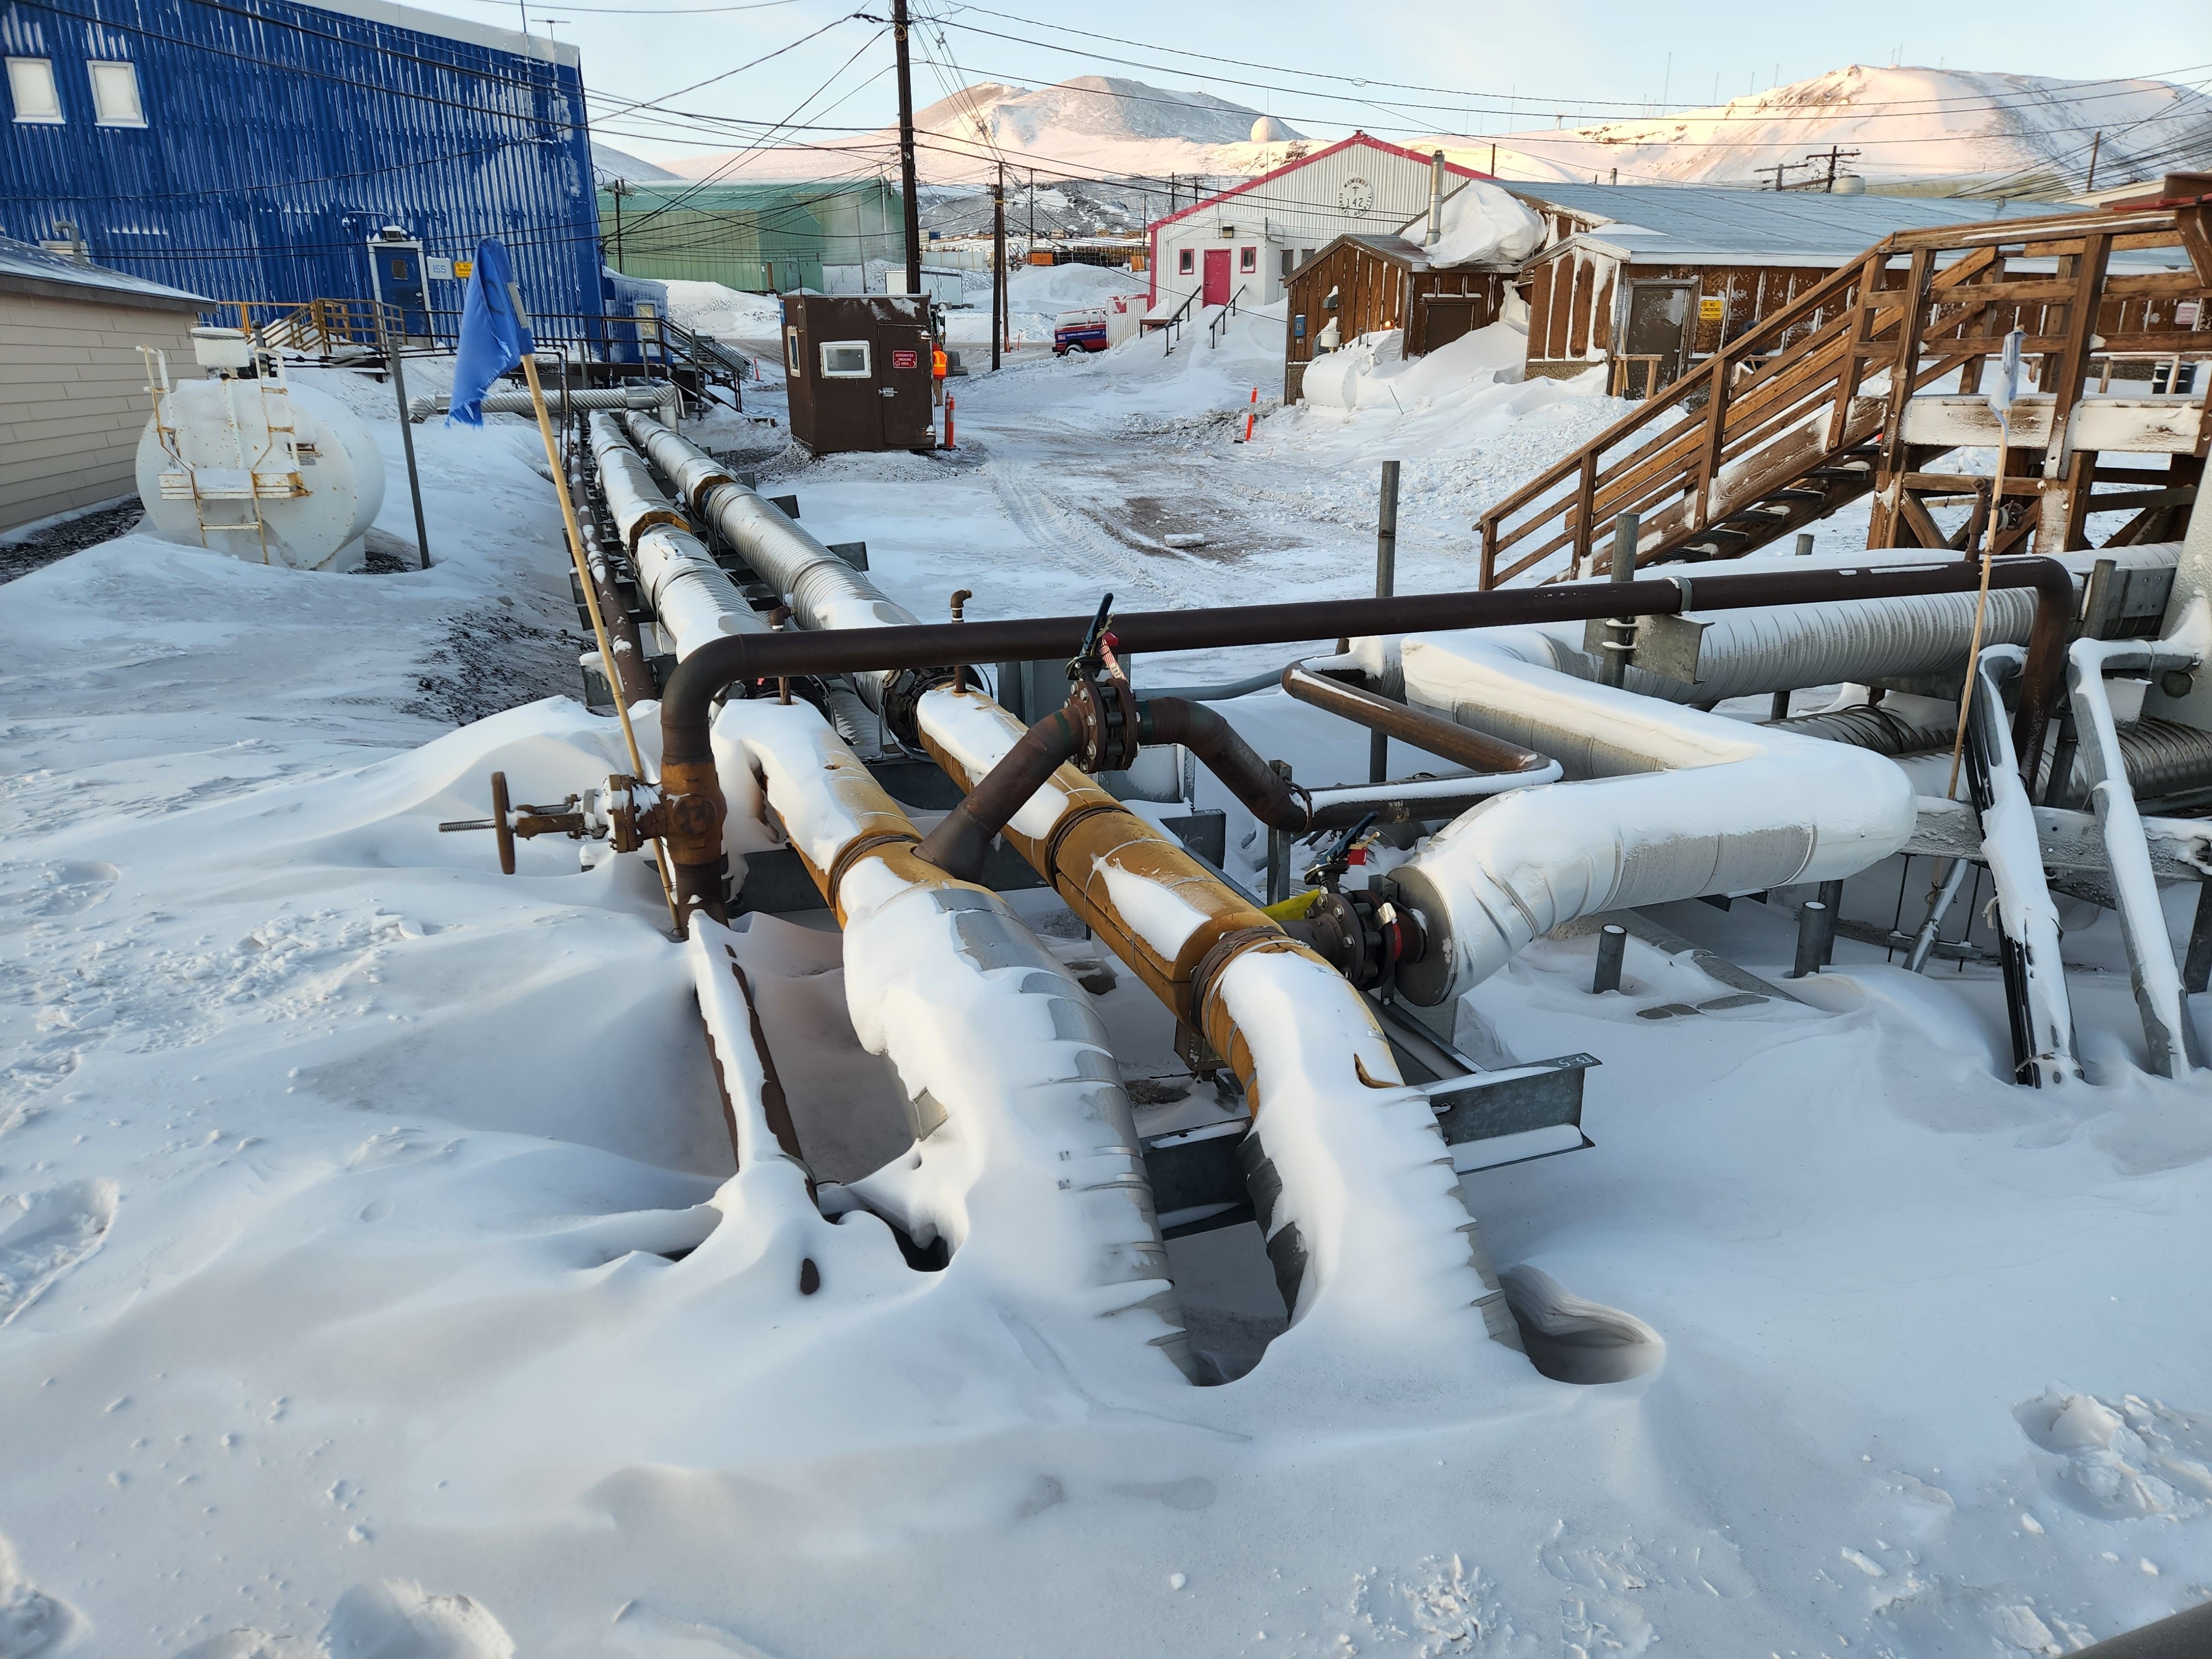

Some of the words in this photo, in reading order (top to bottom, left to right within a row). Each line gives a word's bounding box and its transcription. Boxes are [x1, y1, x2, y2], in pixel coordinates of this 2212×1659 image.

[1343, 178, 1369, 188] MCMURDO
[1346, 197, 1363, 207] 142
[433, 265, 446, 273] 155
